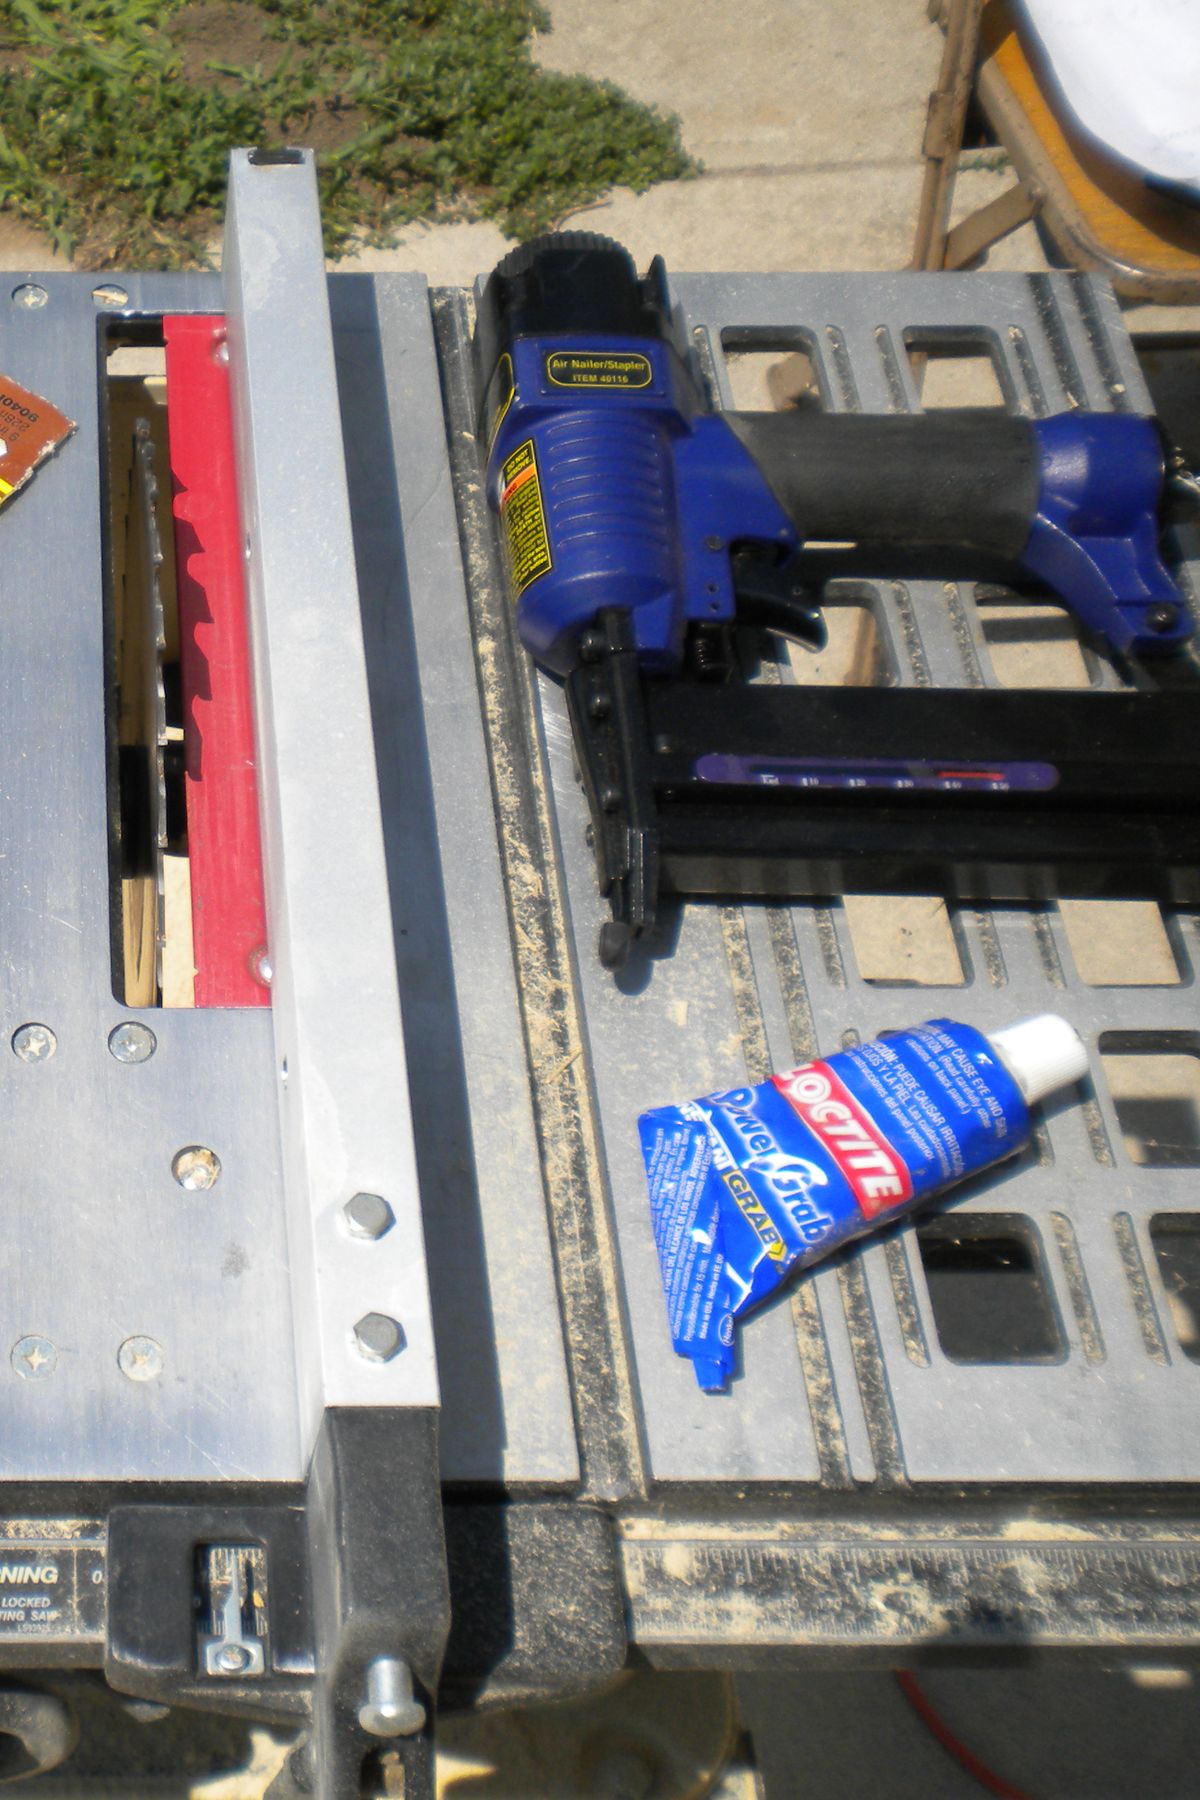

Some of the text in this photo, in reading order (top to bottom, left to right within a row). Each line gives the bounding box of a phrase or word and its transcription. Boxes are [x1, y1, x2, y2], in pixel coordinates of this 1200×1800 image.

[552, 358, 645, 371] Air Nailer/Stapler
[572, 373, 628, 383] ITEM 40116
[8, 431, 19, 443] 9
[877, 1064, 889, 1076] Y
[936, 1033, 954, 1053] MAY
[951, 1047, 979, 1080] CAUSE
[970, 1077, 989, 1097] EYE
[983, 1094, 1005, 1117] AND
[882, 1071, 899, 1090] LA
[938, 1053, 961, 1078] (Read
[952, 1075, 982, 1108] carefully
[891, 1064, 920, 1094] PUEDE
[914, 1089, 948, 1127] CAUSAR
[892, 1085, 913, 1106] PIEL.
[926, 1062, 972, 1117] on back panel.)
[883, 1095, 898, 1110] del
[890, 1107, 911, 1129] panel
[781, 1065, 901, 1201] LOCTITE
[679, 1200, 689, 1214] LOS
[727, 1172, 782, 1246] GRAB
[774, 1162, 834, 1241] Grab
[677, 1214, 686, 1224] DE
[696, 1272, 705, 1281] 15
[91, 1572, 102, 1583] 0
[1, 1597, 50, 1607] LOCKED
